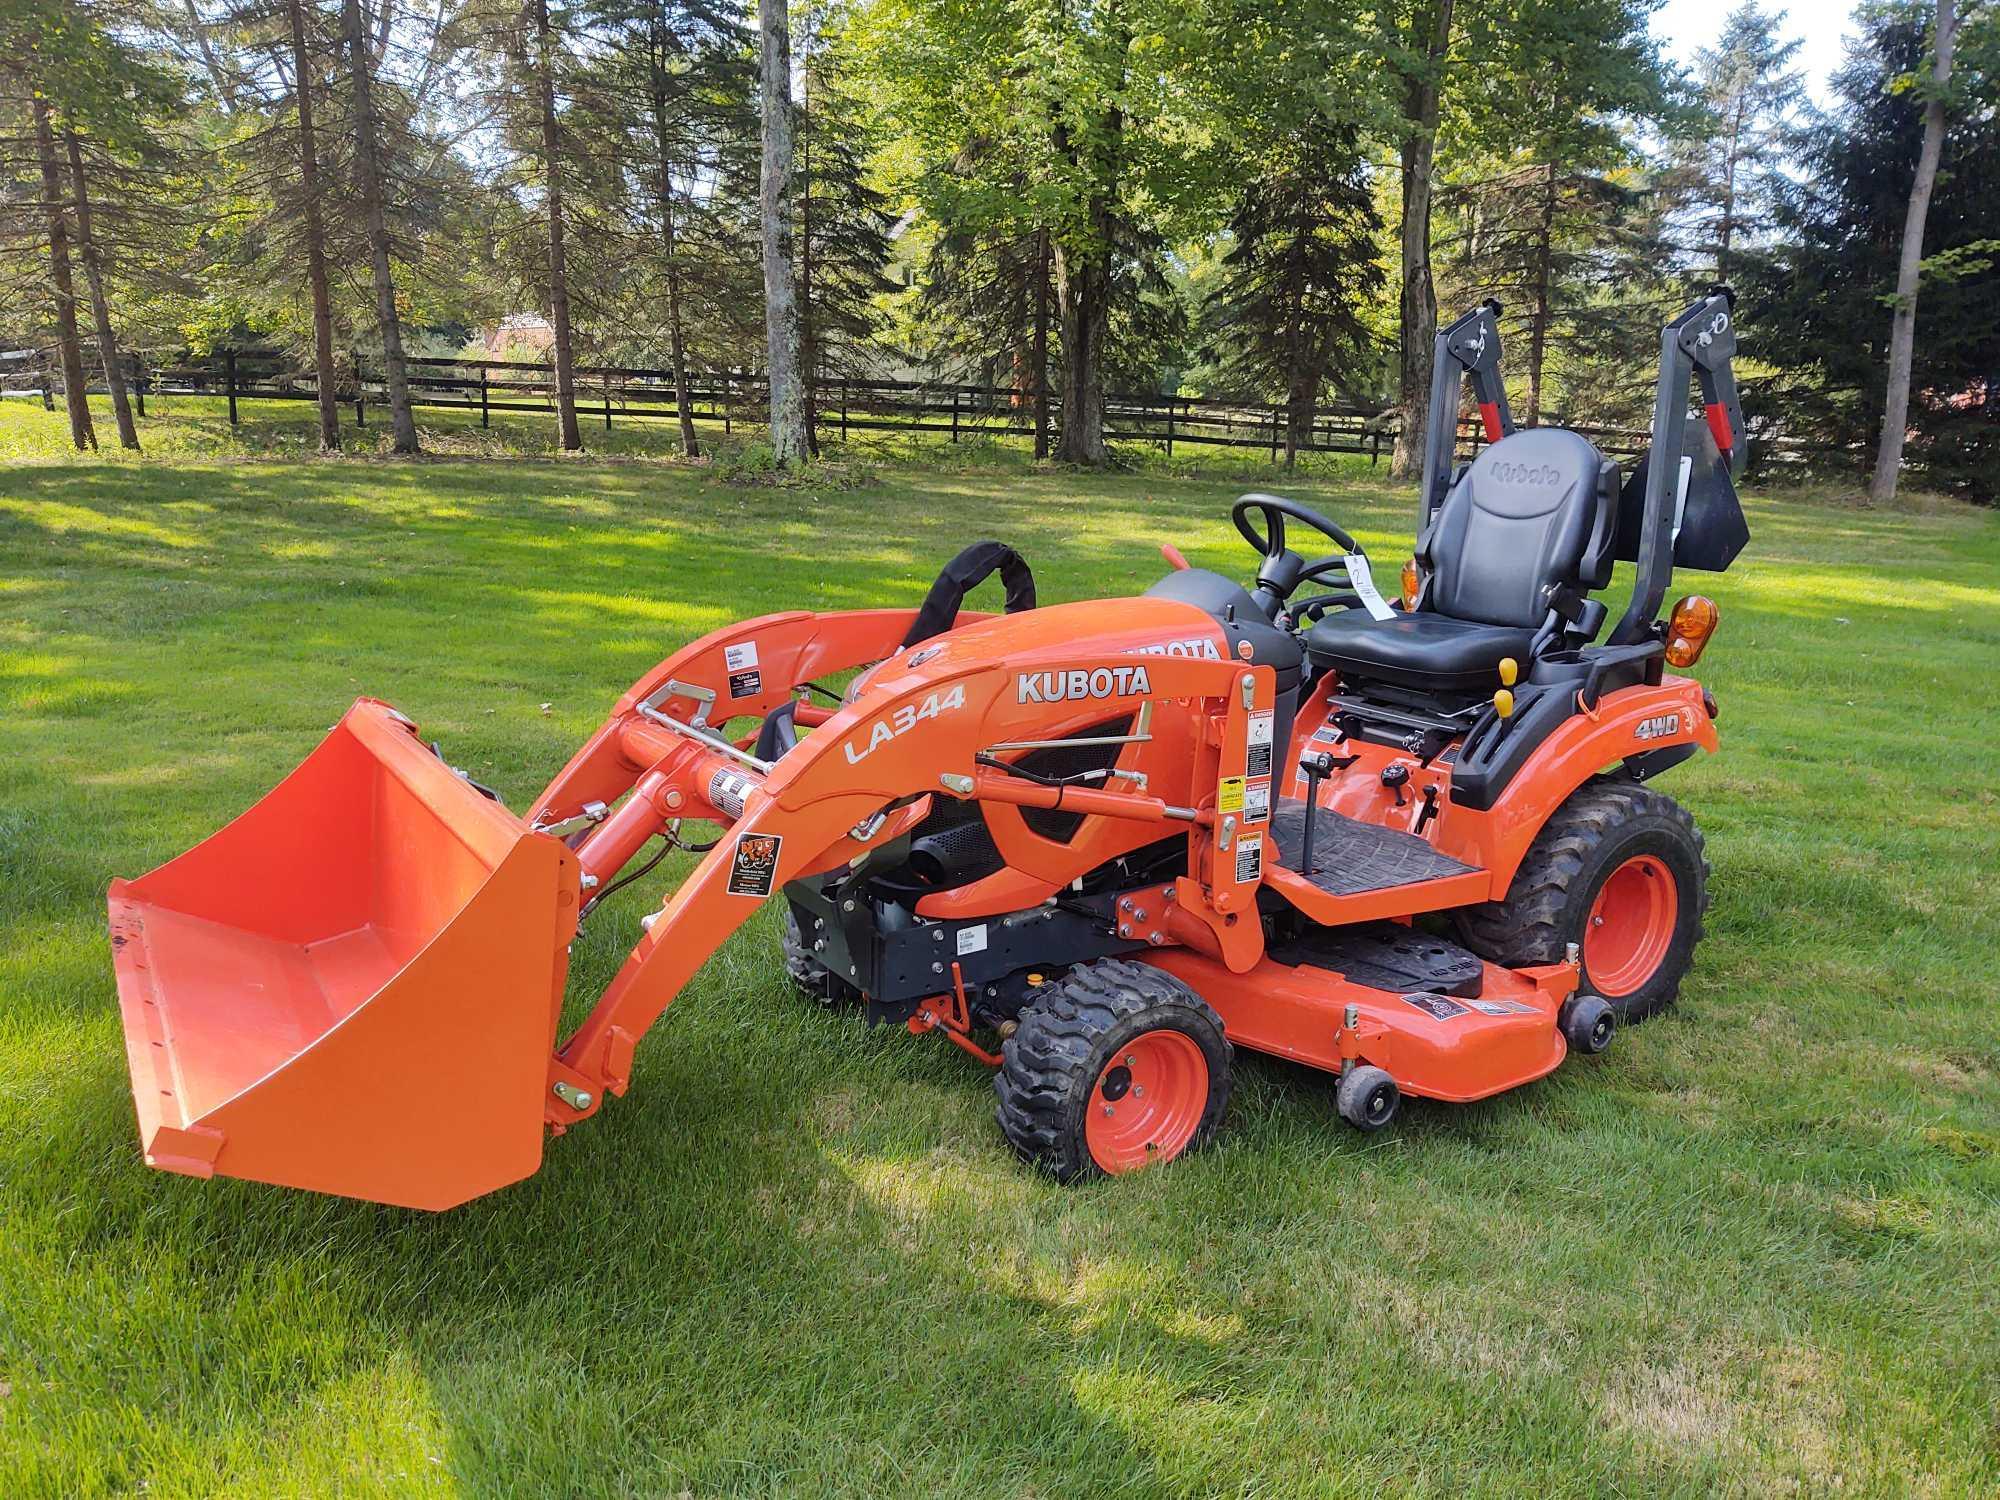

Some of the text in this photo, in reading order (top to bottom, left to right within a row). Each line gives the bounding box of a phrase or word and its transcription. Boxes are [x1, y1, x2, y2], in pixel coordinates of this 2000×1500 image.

[1017, 666, 1152, 704] KUBOTA
[844, 684, 966, 765] LA344
[1634, 714, 1679, 740] 4WD
